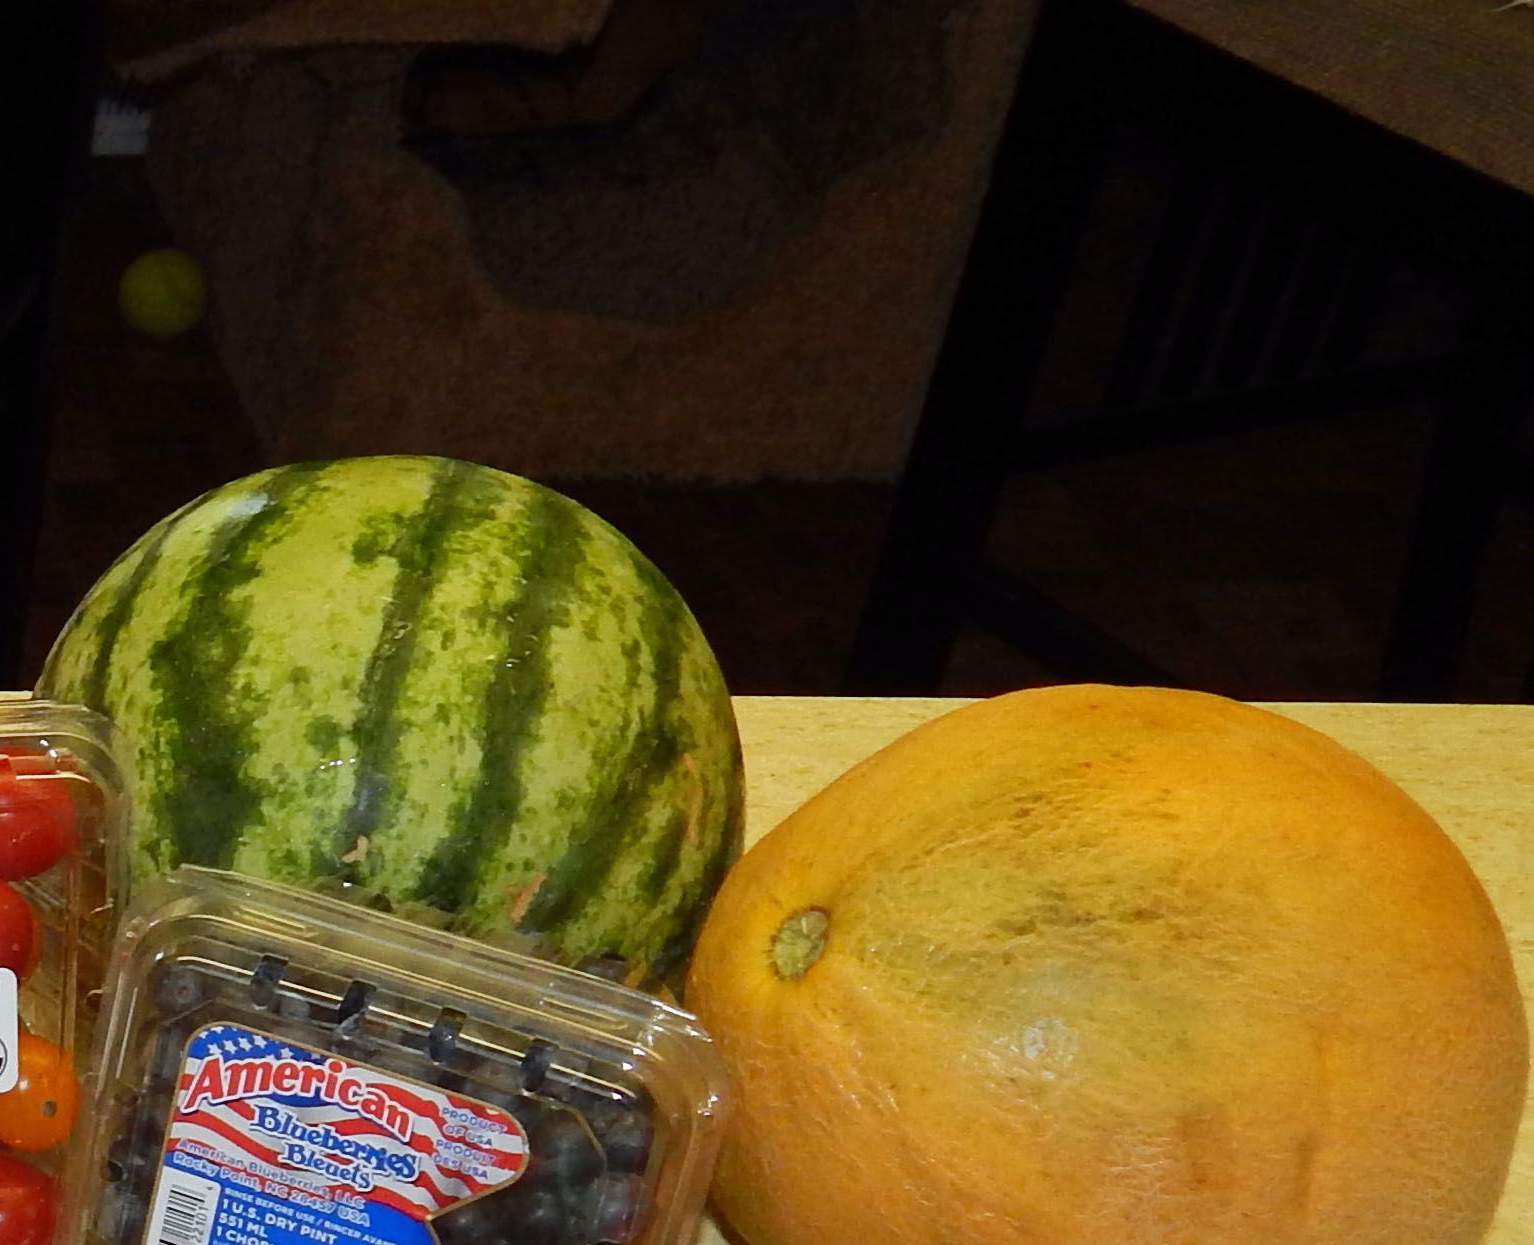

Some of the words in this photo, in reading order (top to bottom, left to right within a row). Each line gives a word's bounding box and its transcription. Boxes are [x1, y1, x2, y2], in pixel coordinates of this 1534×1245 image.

[181, 1056, 412, 1140] American
[254, 1104, 418, 1179] Blueberries
[442, 1107, 506, 1134] PRODUCT
[445, 1125, 463, 1135] OF
[467, 1131, 492, 1146] USA
[284, 1142, 372, 1190] Bleuets
[433, 1154, 458, 1169] DES
[463, 1164, 488, 1180] USA
[436, 1139, 496, 1162] PRODUIT
[172, 1152, 220, 1177] Rocky
[220, 1166, 263, 1193] Point,
[265, 1180, 289, 1199] NC
[289, 1189, 337, 1214] 28457
[337, 1207, 371, 1228] USA
[177, 1139, 245, 1170] American
[248, 1161, 332, 1200] Blueberries,
[334, 1189, 366, 1210] LLC
[191, 1205, 209, 1244] 22101
[216, 1226, 222, 1237] 1
[218, 1211, 244, 1229] 551
[246, 1221, 268, 1238] ML
[223, 1198, 229, 1209] 1
[232, 1202, 261, 1221] U.S.
[264, 1212, 298, 1232] DRY
[299, 1224, 338, 1245] PINT
[224, 1187, 254, 1203] RINSE
[255, 1197, 294, 1217] BEFORE
[295, 1210, 316, 1224] USE
[323, 1220, 361, 1239] RINCER
